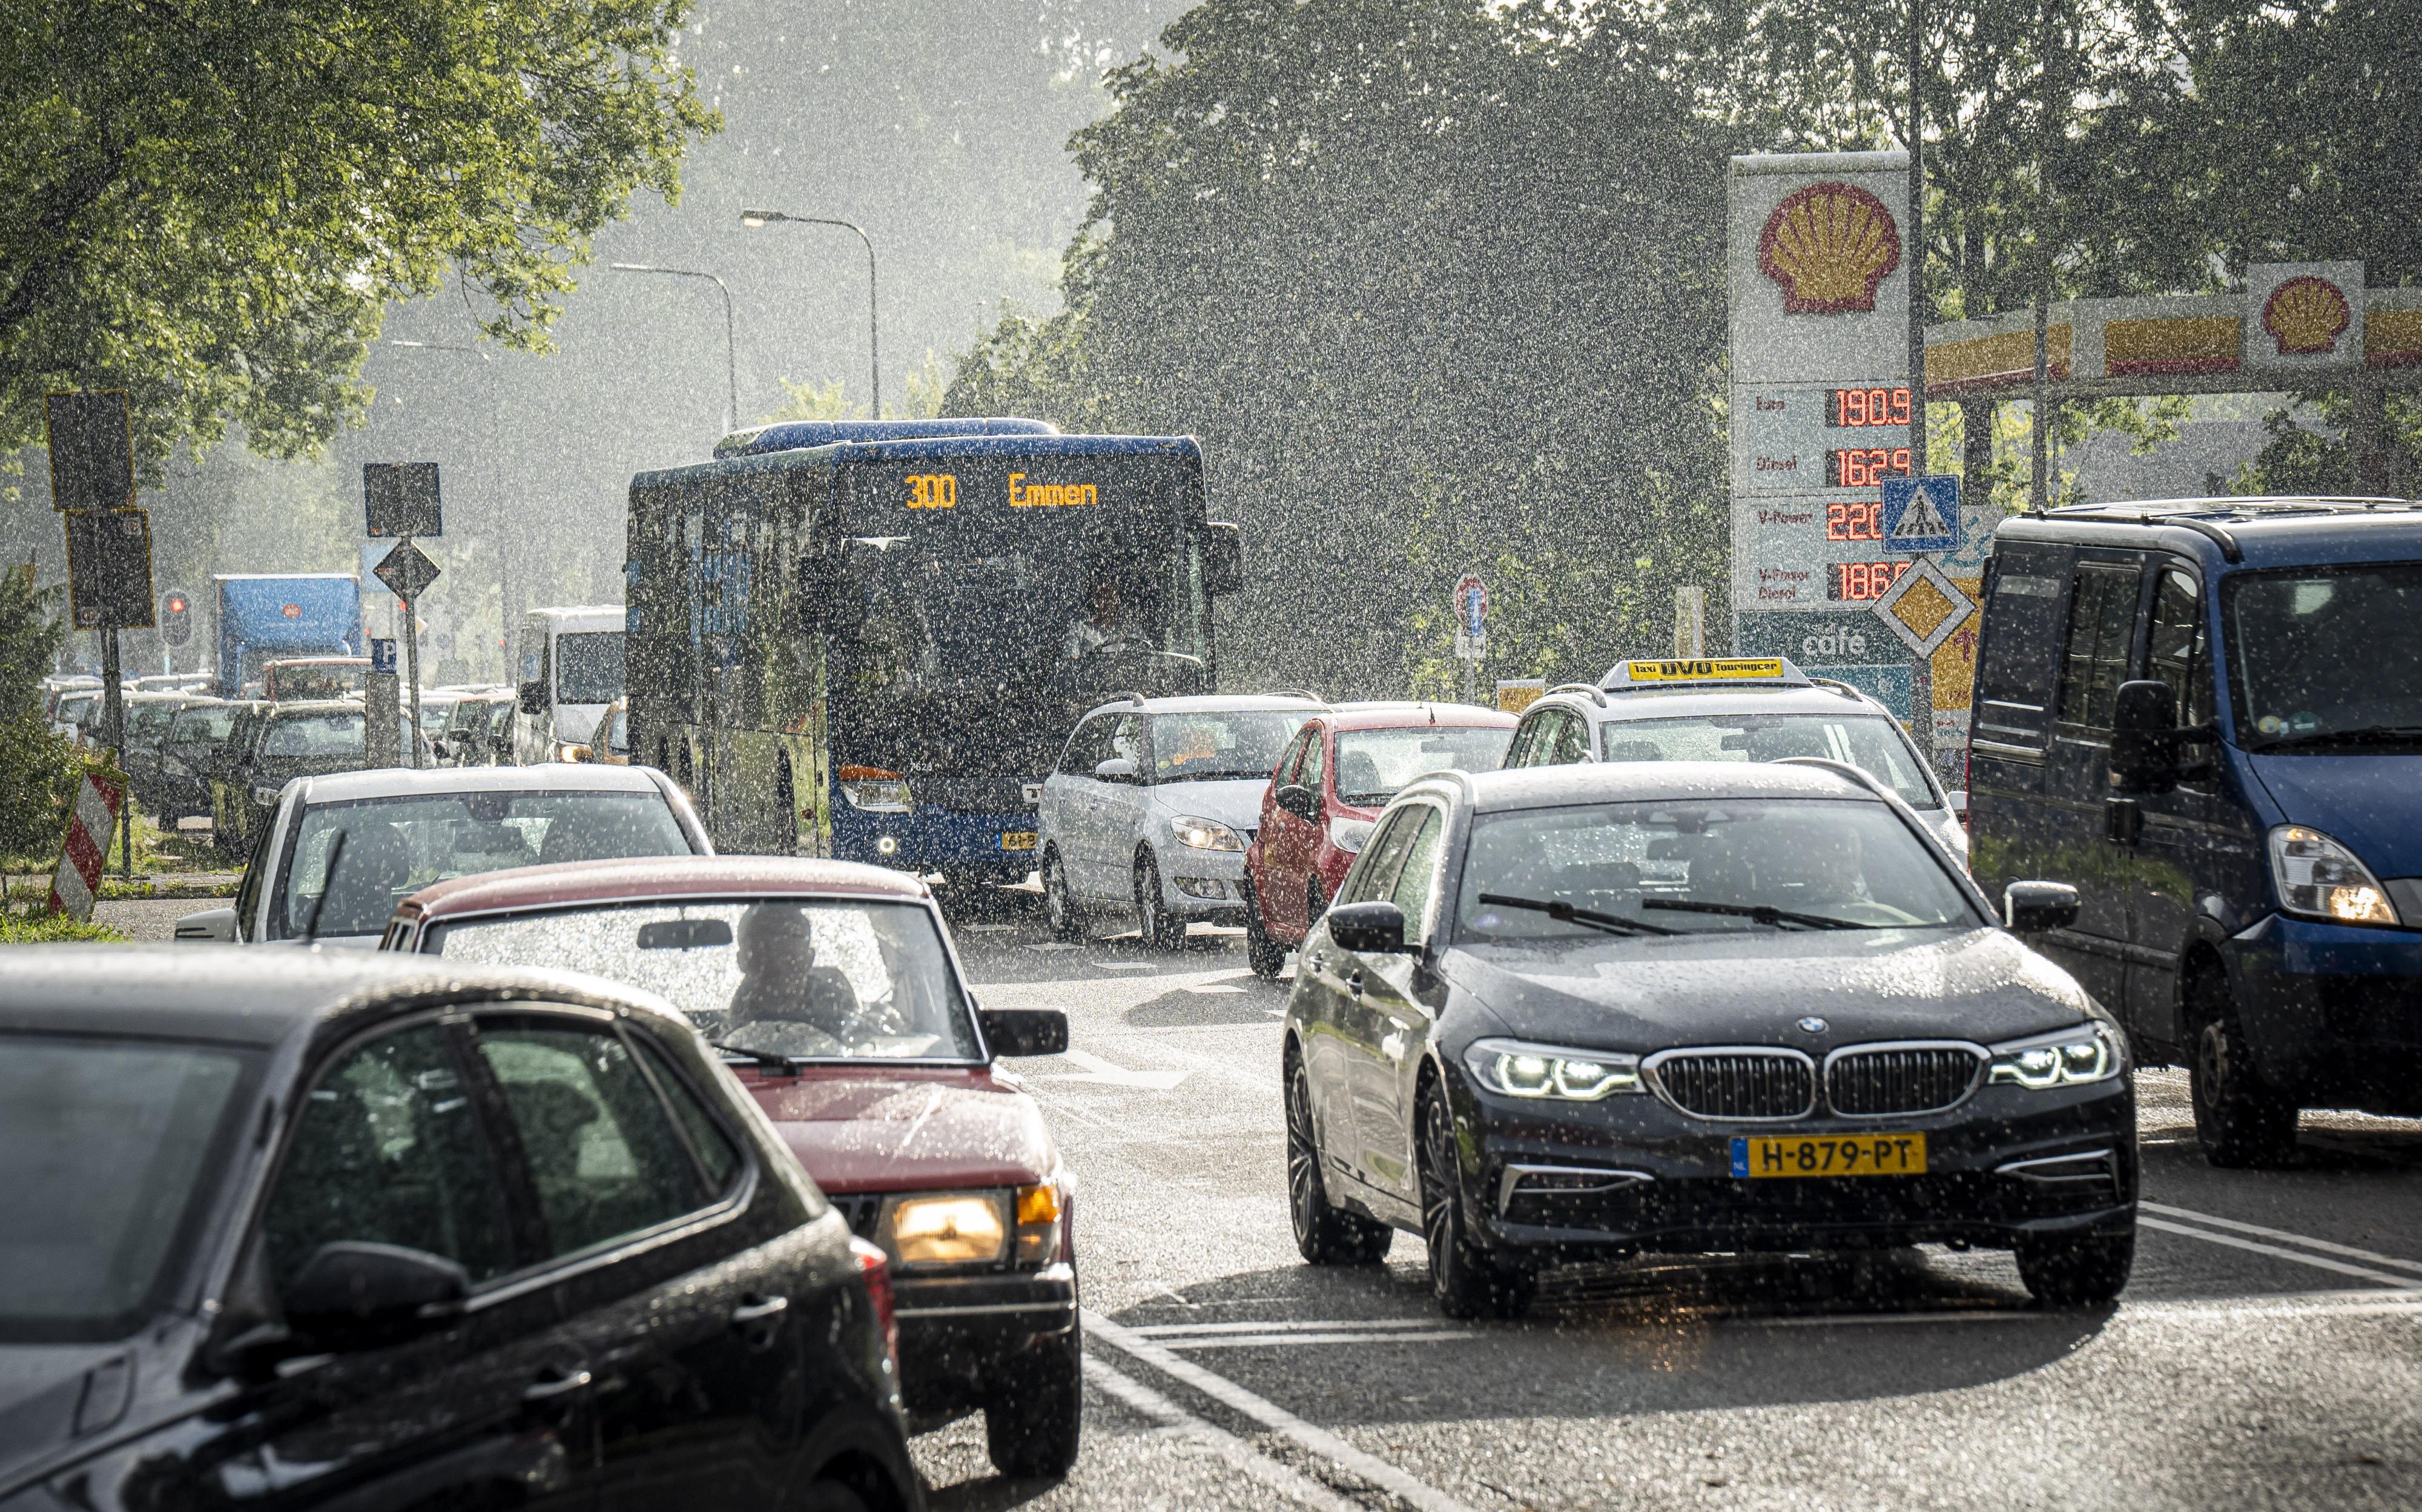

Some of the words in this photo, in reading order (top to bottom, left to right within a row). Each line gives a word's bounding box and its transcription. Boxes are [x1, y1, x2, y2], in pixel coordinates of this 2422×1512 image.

[1756, 455, 1797, 471] Diesel
[905, 474, 955, 509] 300
[1009, 472, 1098, 507] Emmen
[1758, 509, 1813, 524] V-Power
[383, 641, 397, 663] P
[1715, 663, 1777, 672] Touringcar
[1761, 1139, 1912, 1172] H-879-PT
